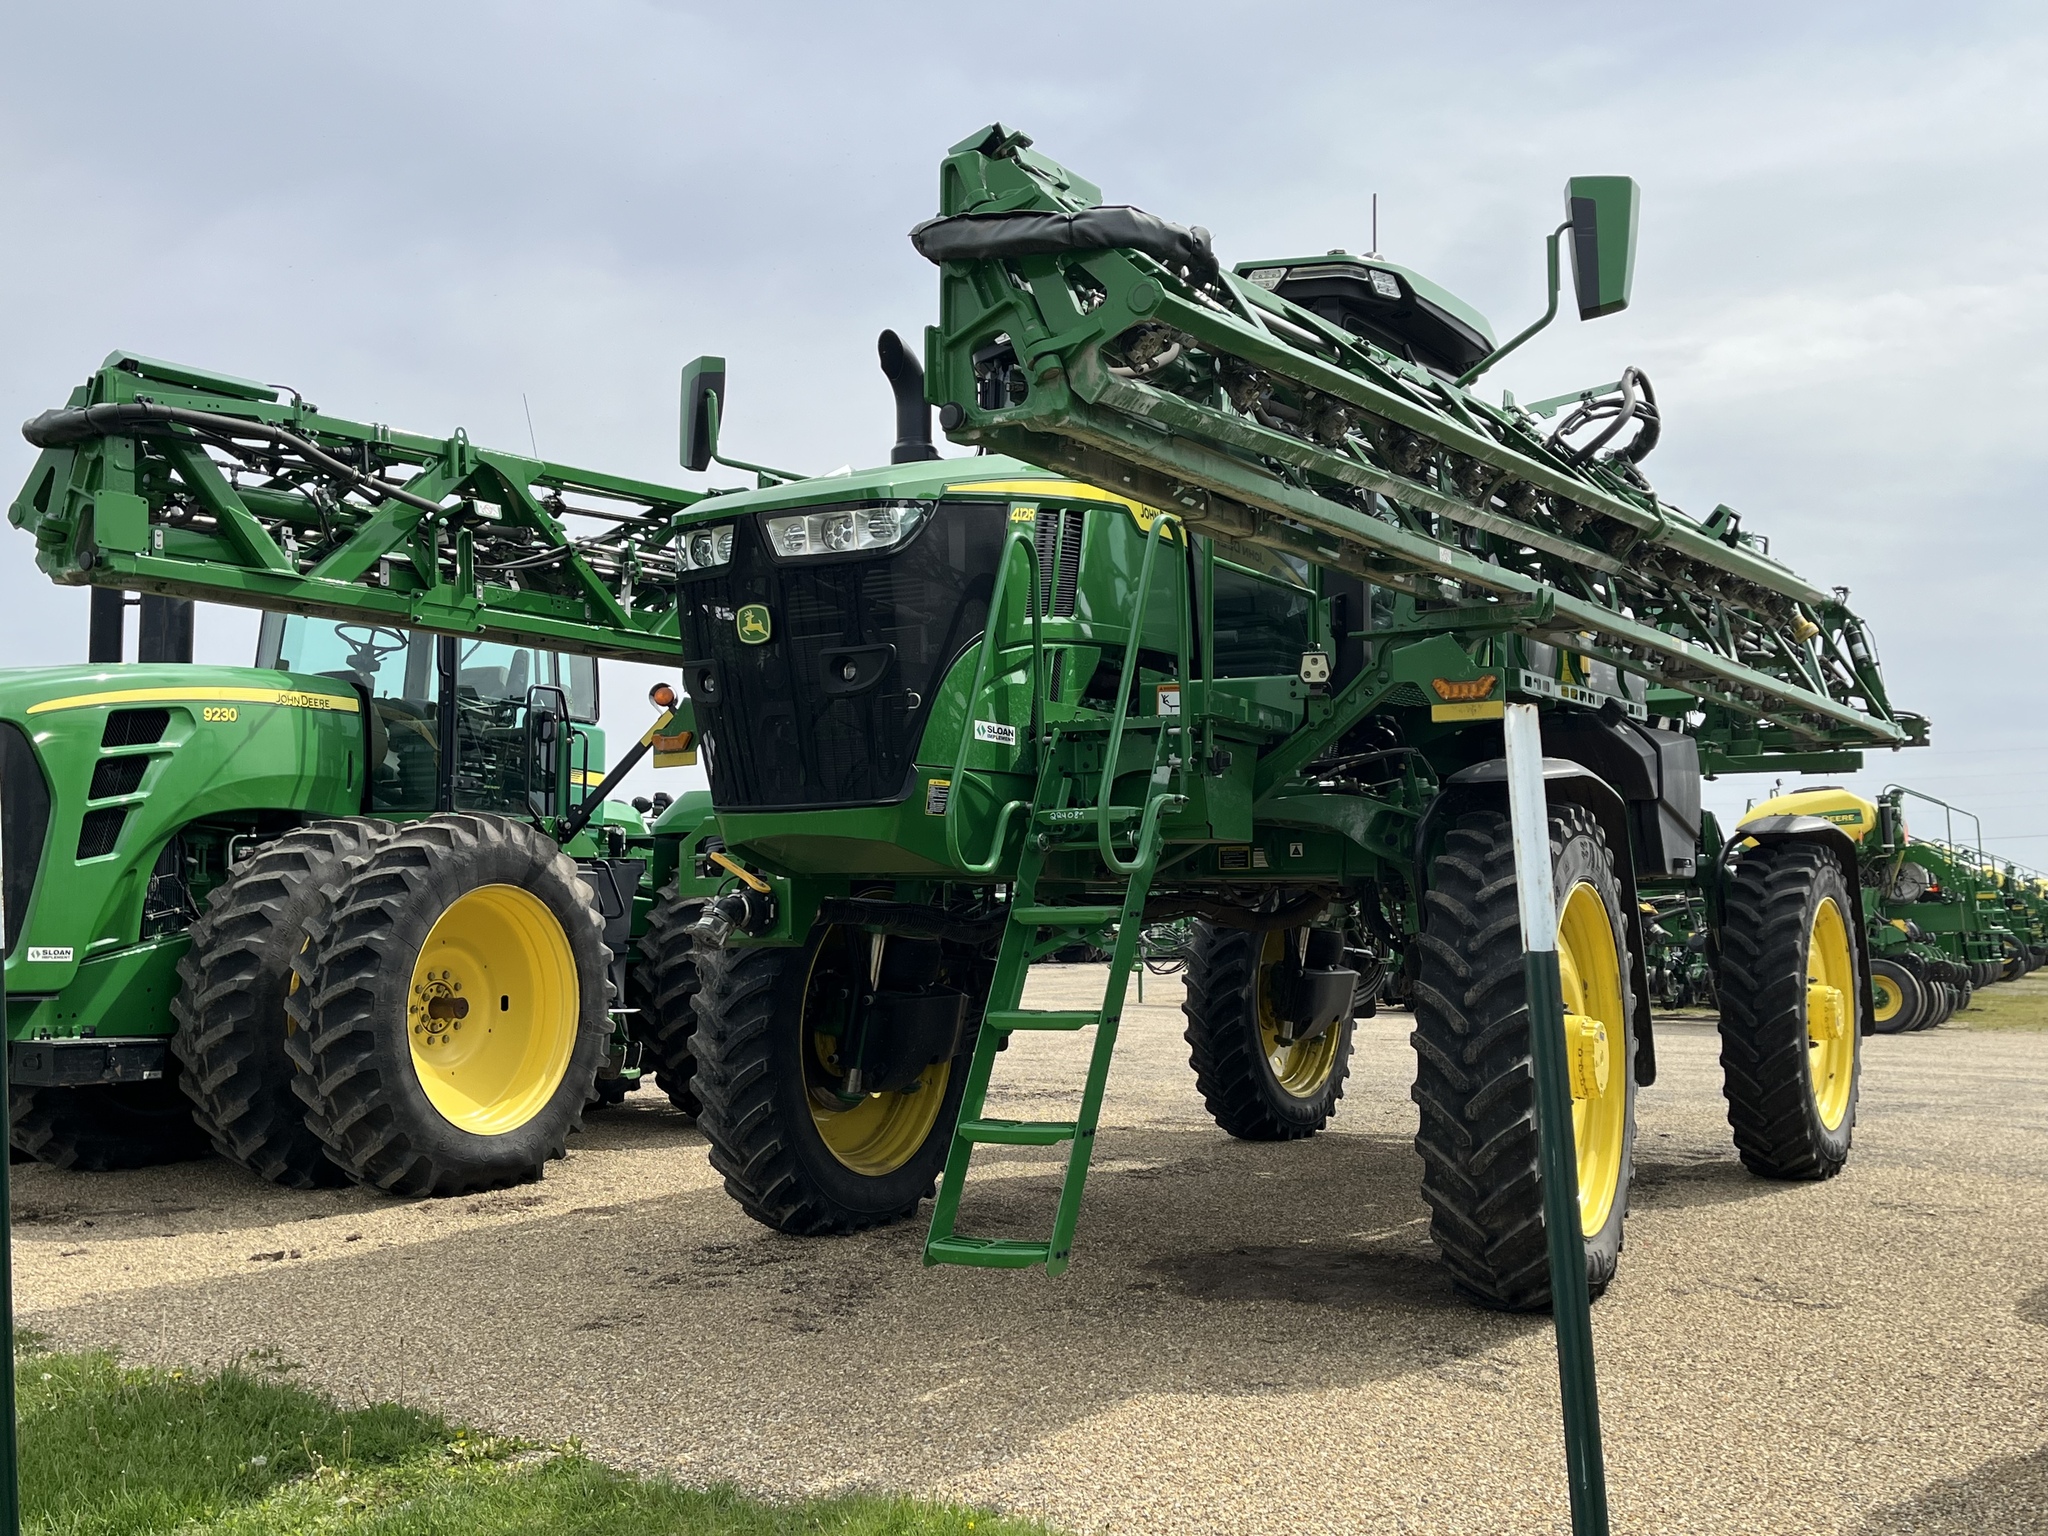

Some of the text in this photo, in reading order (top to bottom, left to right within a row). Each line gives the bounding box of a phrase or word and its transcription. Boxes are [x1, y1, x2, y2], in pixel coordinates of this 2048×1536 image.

[1011, 507, 1035, 524] 412R
[276, 692, 330, 708] JOHN DEERE
[203, 706, 238, 721] 9230
[987, 725, 1014, 737] SLOAN
